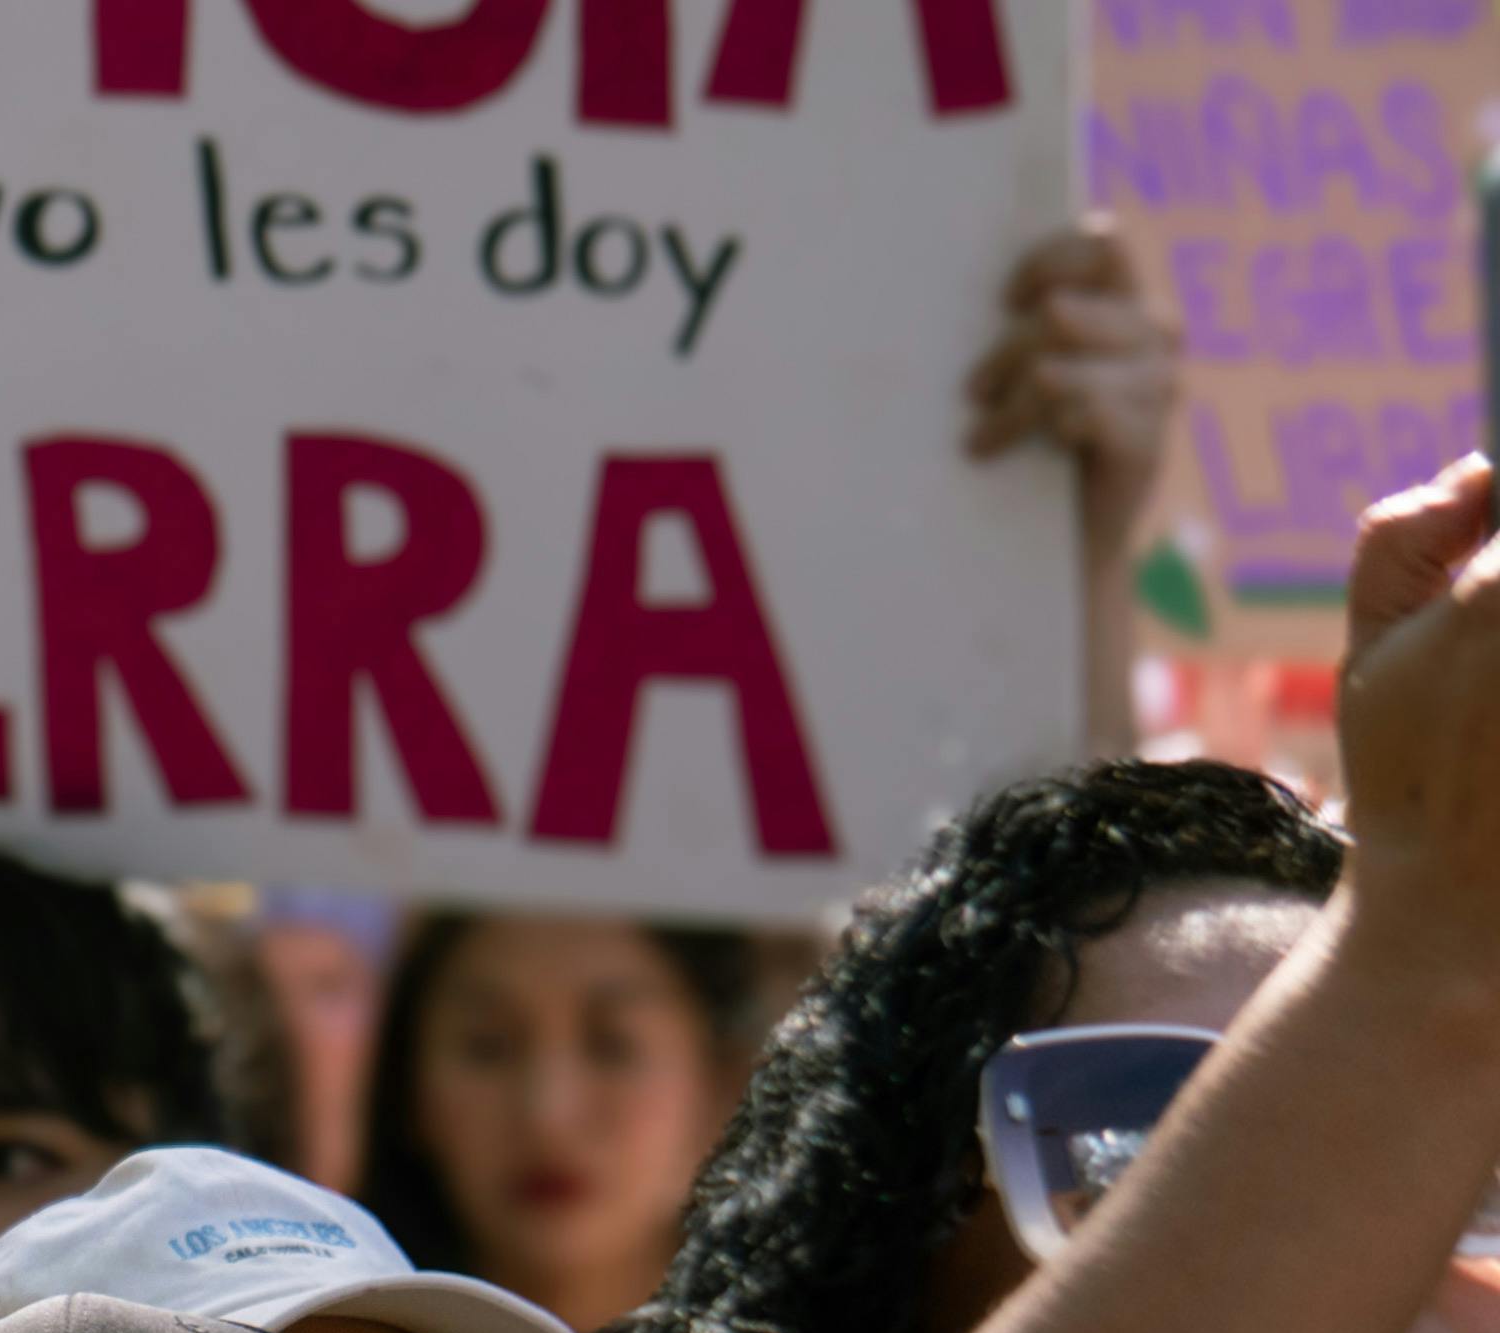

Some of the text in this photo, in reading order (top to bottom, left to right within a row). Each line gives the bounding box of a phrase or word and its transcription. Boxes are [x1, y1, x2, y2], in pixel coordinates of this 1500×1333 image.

[196, 135, 424, 288] les
[476, 151, 743, 360] doy
[168, 1223, 229, 1261] LOS
